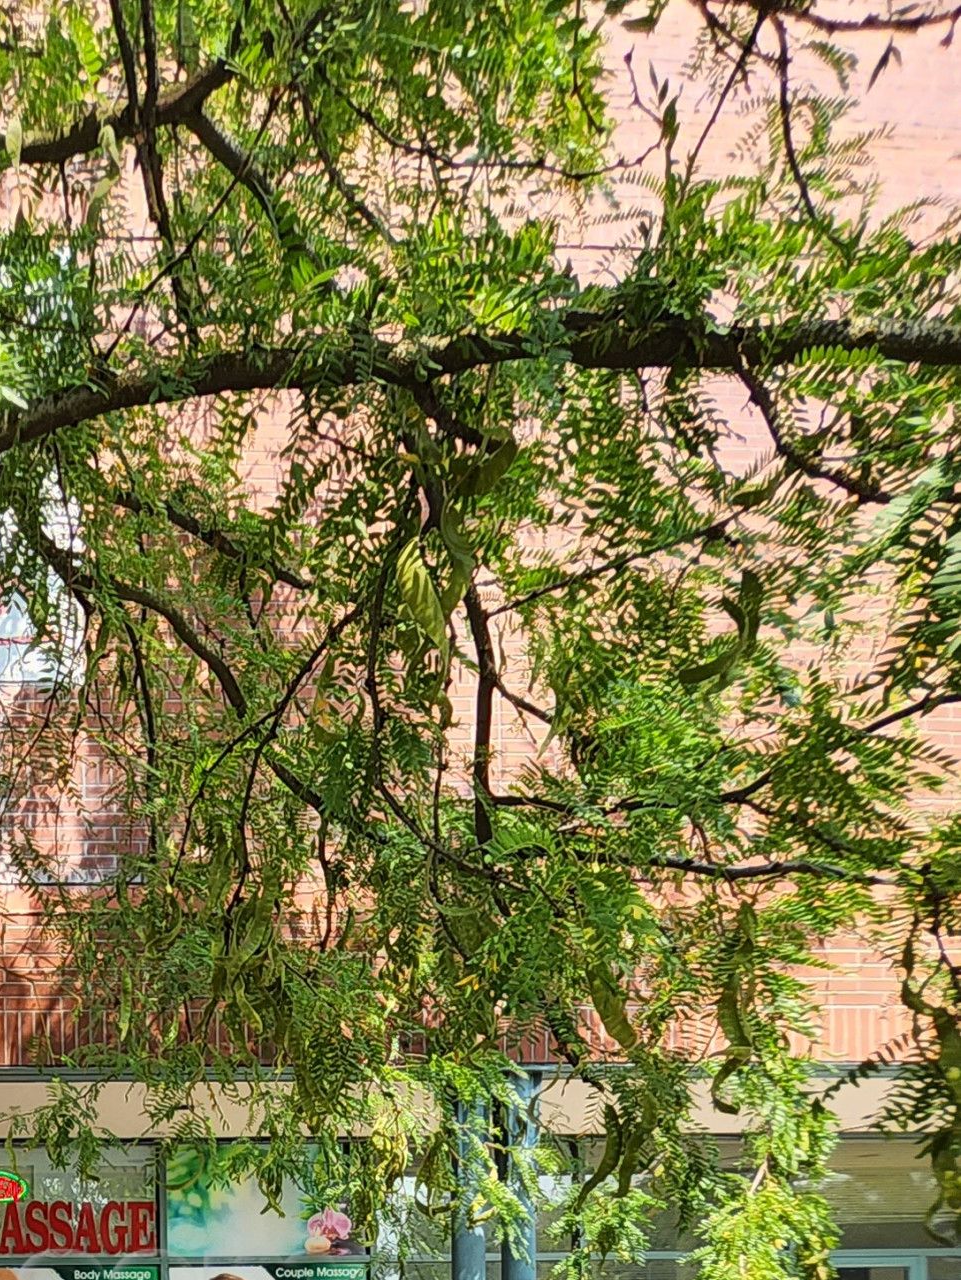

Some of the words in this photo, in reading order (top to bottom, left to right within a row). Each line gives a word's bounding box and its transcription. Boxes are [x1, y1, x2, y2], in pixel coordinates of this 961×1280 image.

[74, 1269, 100, 1280] Body
[103, 1269, 152, 1280] Massage
[275, 1267, 314, 1279] Couple
